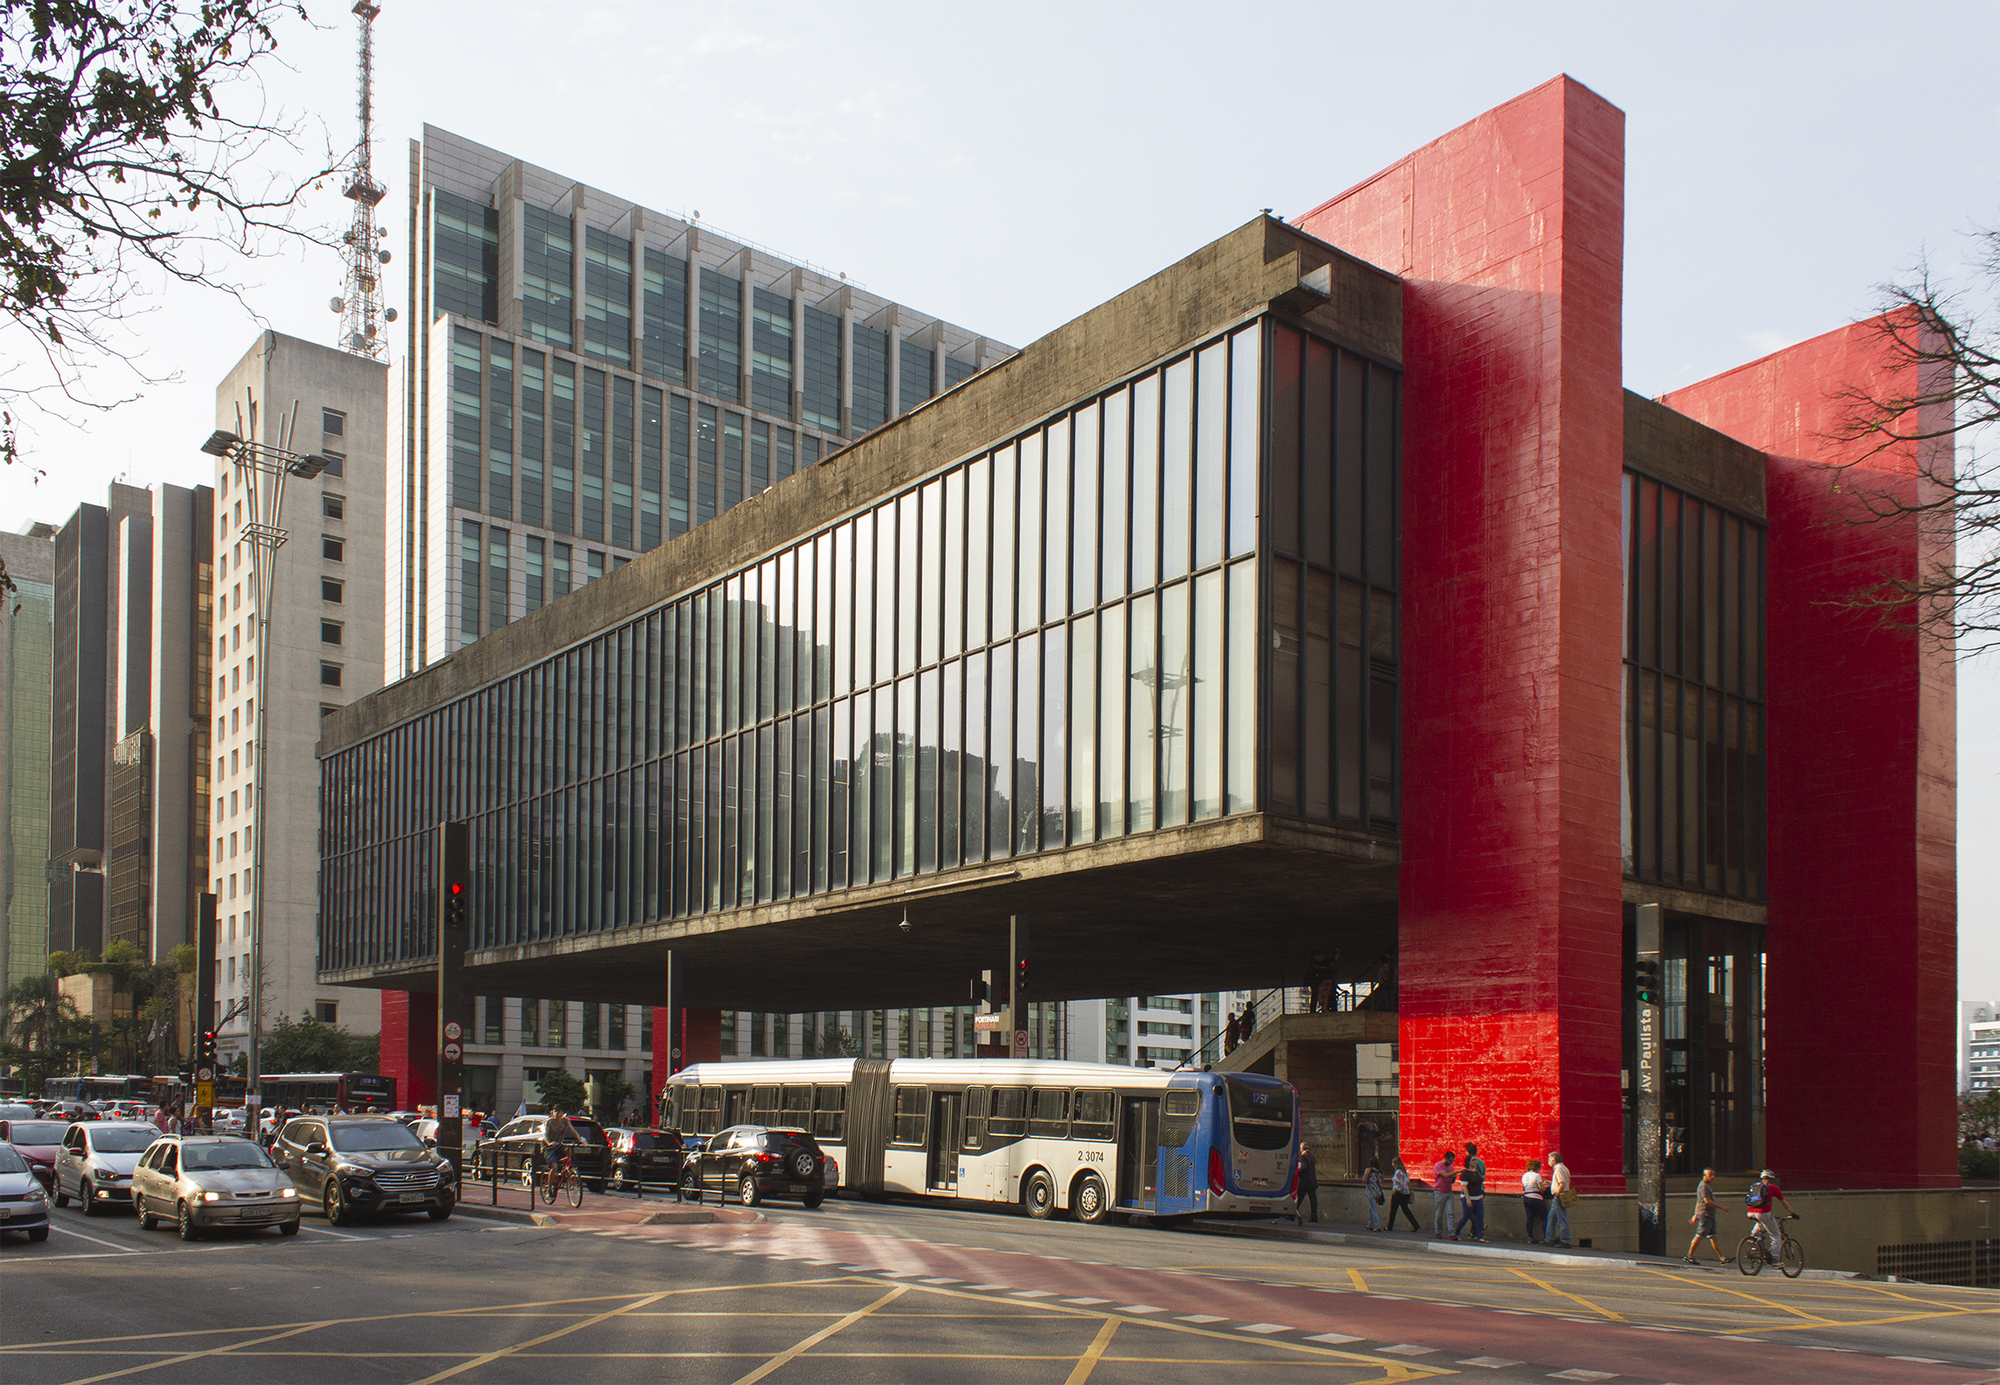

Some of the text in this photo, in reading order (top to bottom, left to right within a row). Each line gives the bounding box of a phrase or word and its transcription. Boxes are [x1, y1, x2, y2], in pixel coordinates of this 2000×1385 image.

[1640, 1008, 1652, 1093] Av. Paulista
[1077, 1150, 1104, 1162] 2 3074
